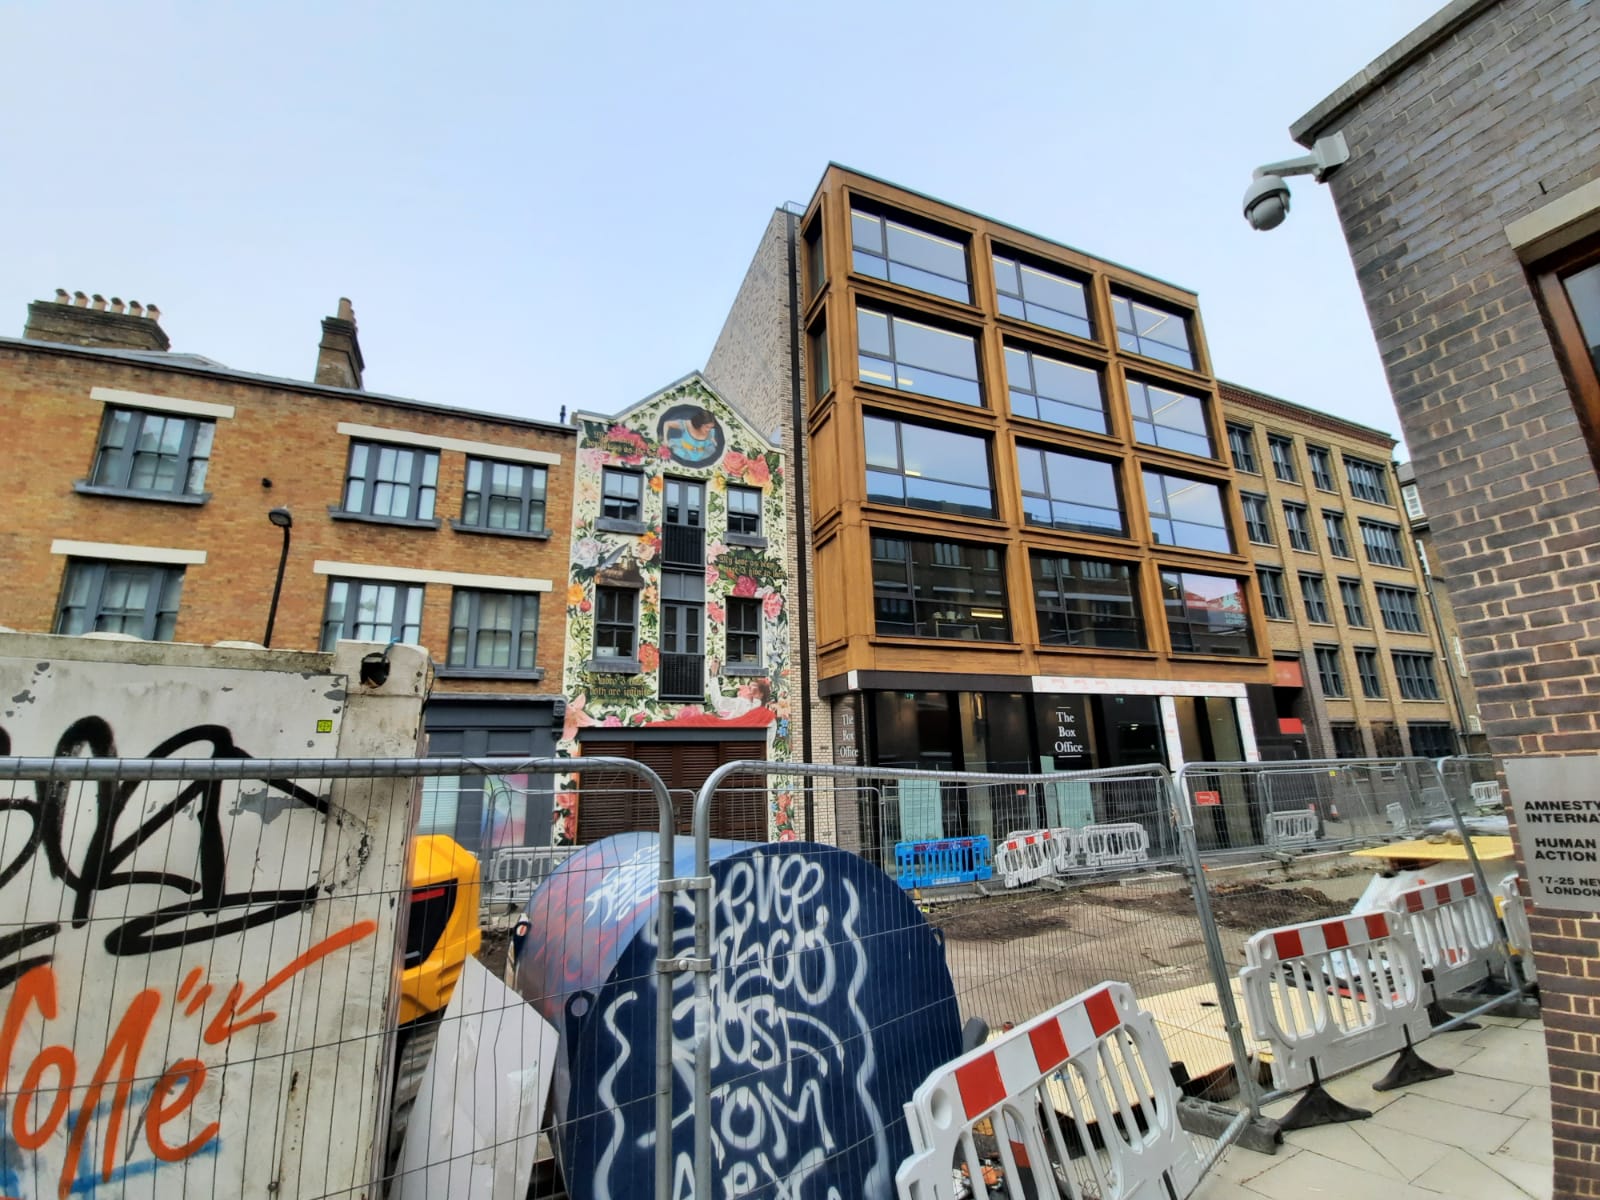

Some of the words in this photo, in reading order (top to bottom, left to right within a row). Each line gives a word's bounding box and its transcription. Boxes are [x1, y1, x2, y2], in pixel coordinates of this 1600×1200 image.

[841, 714, 855, 726] The
[1055, 711, 1075, 723] The
[842, 728, 856, 741] Box
[1058, 726, 1077, 737] Box
[839, 745, 859, 758] Office
[1054, 741, 1083, 753] Office
[1524, 800, 1600, 811] AMNESTY
[1535, 837, 1597, 849] HUMAN
[1535, 850, 1597, 862] ACTION
[1538, 876, 1575, 886] 17-25
[1545, 886, 1600, 897] LONDON
